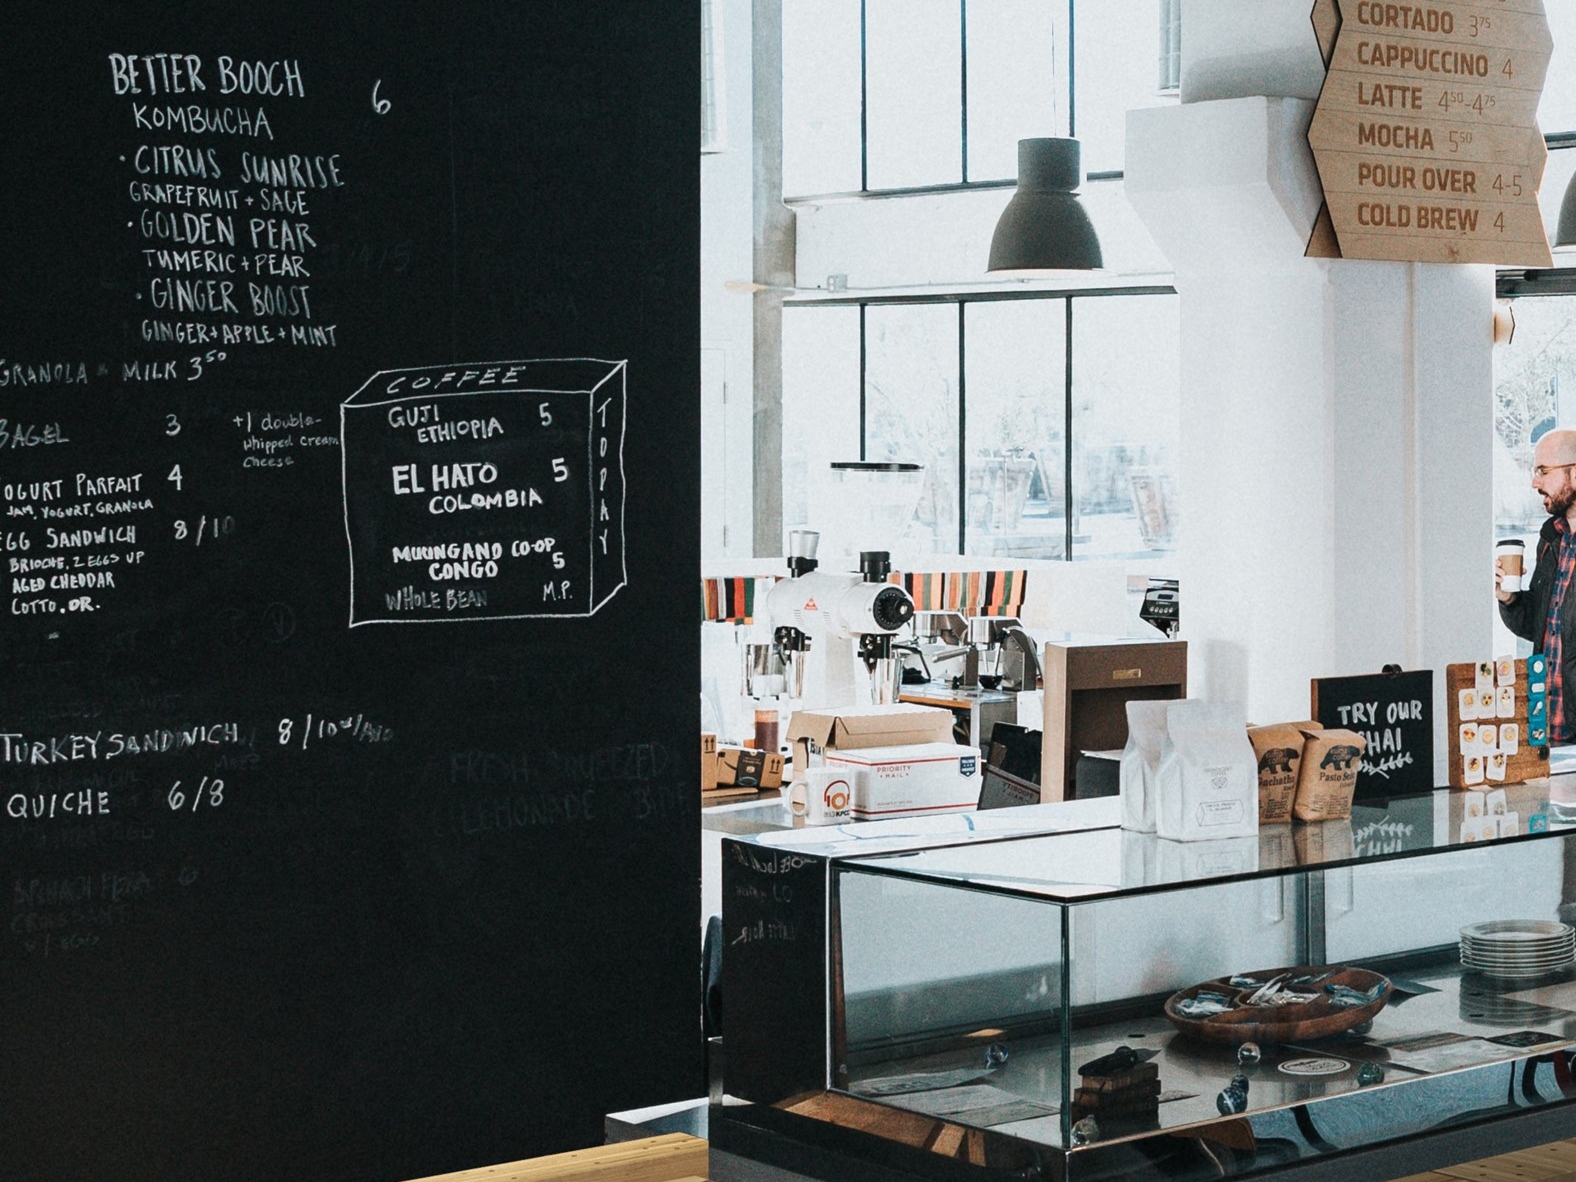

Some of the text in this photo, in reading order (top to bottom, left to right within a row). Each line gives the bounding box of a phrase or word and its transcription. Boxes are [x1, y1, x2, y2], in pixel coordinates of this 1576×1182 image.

[1357, 1, 1454, 35] CORTADO
[109, 53, 305, 97] BETTER BOOCH
[1357, 41, 1513, 80] CAPPUCCINO 4
[371, 80, 392, 115] 6
[1358, 81, 1423, 110] LATTE
[133, 102, 274, 140] KOMBUCHA
[1358, 122, 1435, 151] MOCHA
[135, 145, 345, 188] CITRUS SUNRISE
[1358, 162, 1416, 190] POUR
[1422, 167, 1476, 194] OVER
[129, 181, 240, 210] GRAPEFRUIT
[260, 188, 309, 216] SAGE
[141, 208, 317, 253] GOLDEN PEAR
[1357, 202, 1505, 233] COLD BREW 4
[142, 250, 236, 274] TUMERIC
[255, 254, 310, 278] PEAR
[151, 278, 310, 319] GINGER BOOST
[291, 325, 337, 347] MINT
[0, 359, 88, 387] GRANOLA
[122, 361, 178, 381] MILK
[387, 366, 526, 394] COFFEE
[165, 414, 182, 436] 3
[388, 402, 552, 428] GUJI 5
[417, 417, 504, 443] ETHIOPIA
[0, 464, 183, 502] OGURT PARFAIT 4
[392, 457, 569, 495] EL HATO 5
[96, 498, 154, 514] GRANOLA
[429, 487, 544, 514] COLOMBIA
[0, 531, 31, 550] GG
[46, 525, 136, 549] SANDWICH
[126, 551, 145, 564] UP
[429, 551, 566, 581] CONGO 5
[12, 571, 115, 594] AGED CHEDDAR
[385, 585, 441, 611] WHOLE
[446, 589, 488, 611] BEAN
[1337, 700, 1422, 725] TRY OUR
[0, 731, 101, 765] TURKEY
[106, 722, 239, 760] SANDWICH
[1357, 727, 1401, 757] HAI
[876, 765, 911, 773] PRIORITY
[7, 788, 110, 819] QUICHE
